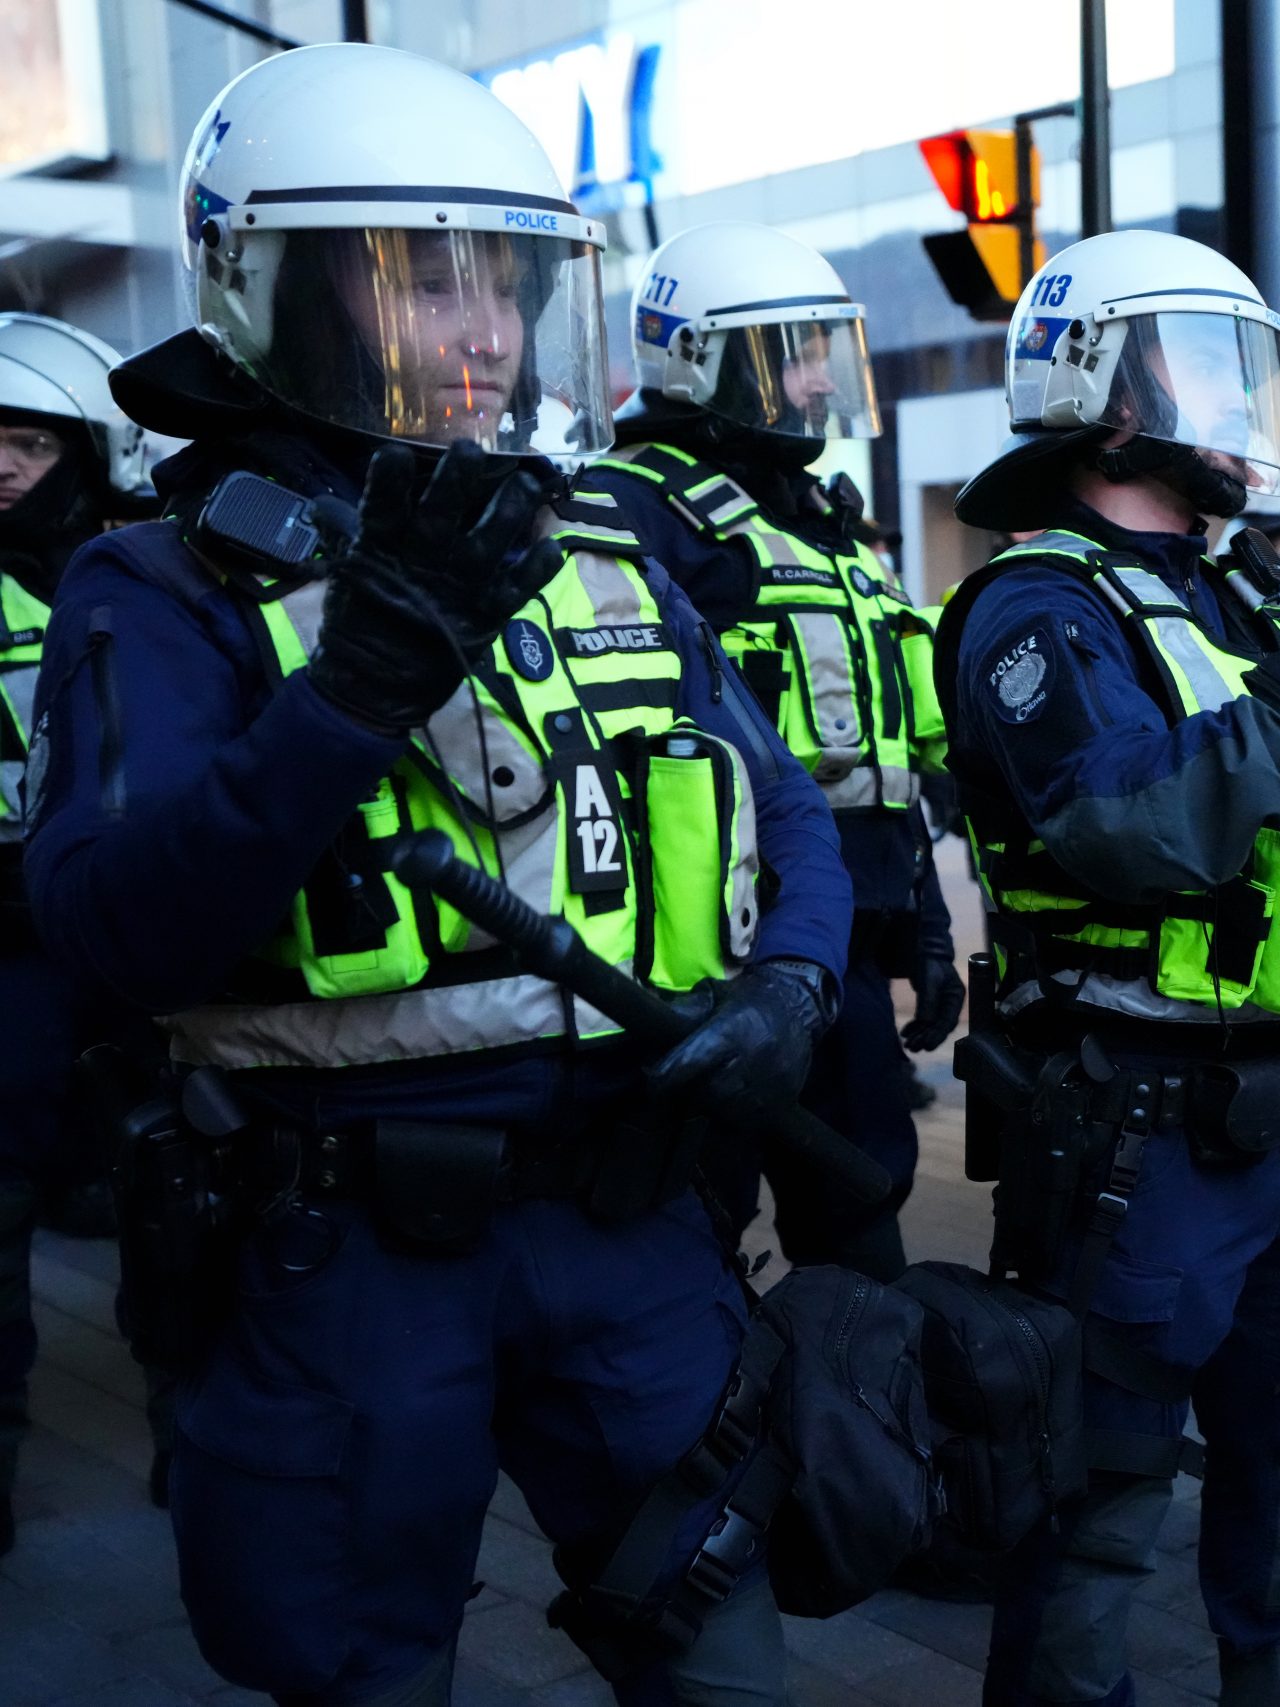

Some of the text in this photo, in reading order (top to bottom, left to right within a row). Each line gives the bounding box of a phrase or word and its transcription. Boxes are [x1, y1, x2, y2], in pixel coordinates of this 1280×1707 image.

[505, 211, 558, 231] POLICE
[1030, 274, 1073, 307] 113
[571, 627, 662, 651] POLICE
[989, 635, 1037, 687] POLICE
[574, 764, 613, 818] A
[576, 819, 622, 874] 12
